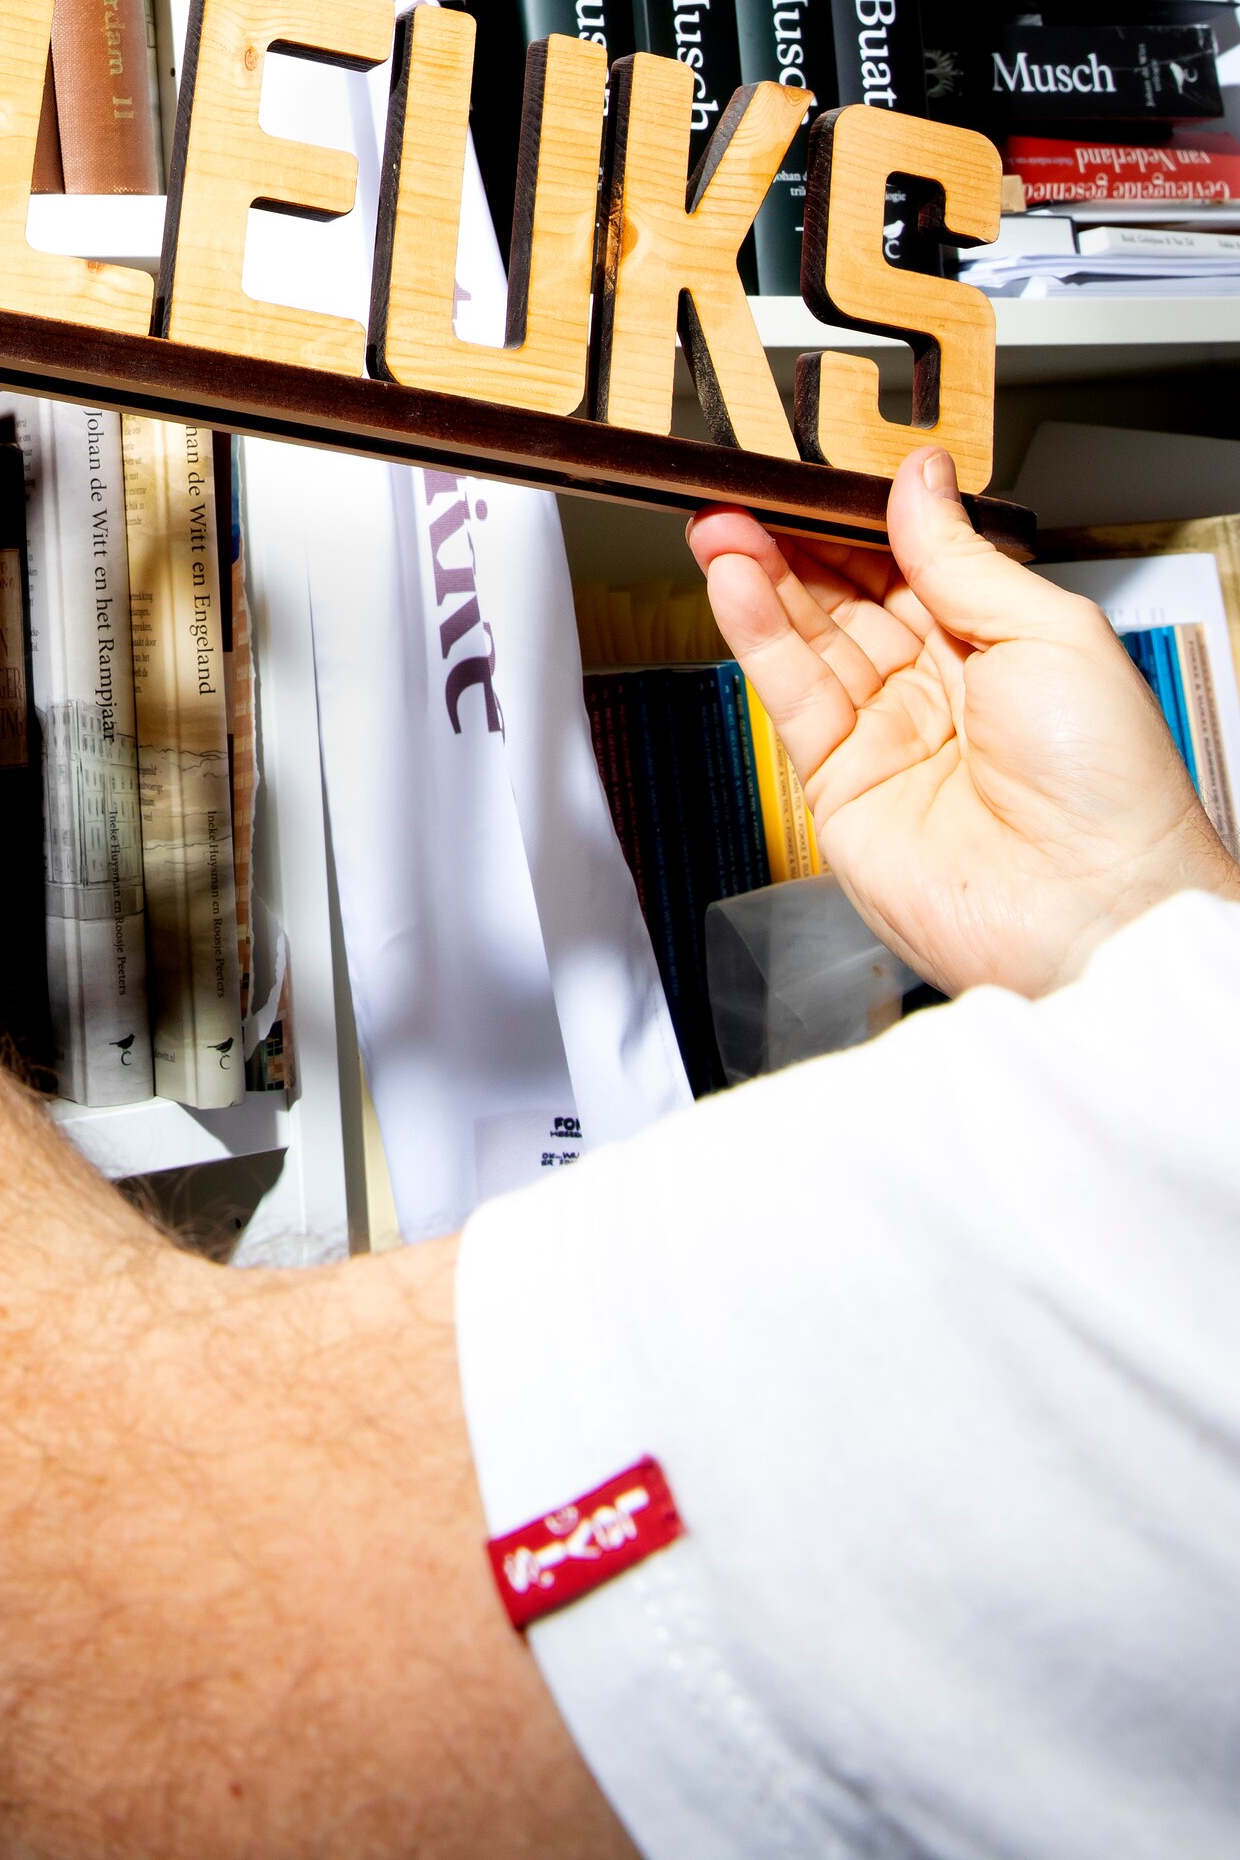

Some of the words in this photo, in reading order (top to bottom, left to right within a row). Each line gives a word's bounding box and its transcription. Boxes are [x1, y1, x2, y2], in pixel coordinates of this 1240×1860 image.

[991, 51, 1118, 93] Musch
[1074, 147, 1177, 174] Nederland
[82, 409, 105, 471] Johan
[89, 477, 107, 503] de
[187, 471, 206, 497] de
[91, 508, 110, 558] Witt
[188, 502, 208, 553] Witt
[94, 565, 108, 591] en
[191, 561, 205, 587] en
[95, 597, 114, 631] het
[190, 594, 216, 696] Engeland
[95, 638, 117, 744] Rampjaar
[207, 843, 220, 898] Huysman
[213, 918, 224, 955] Roosje
[117, 956, 128, 996] Peeters
[215, 957, 226, 999] Peeters
